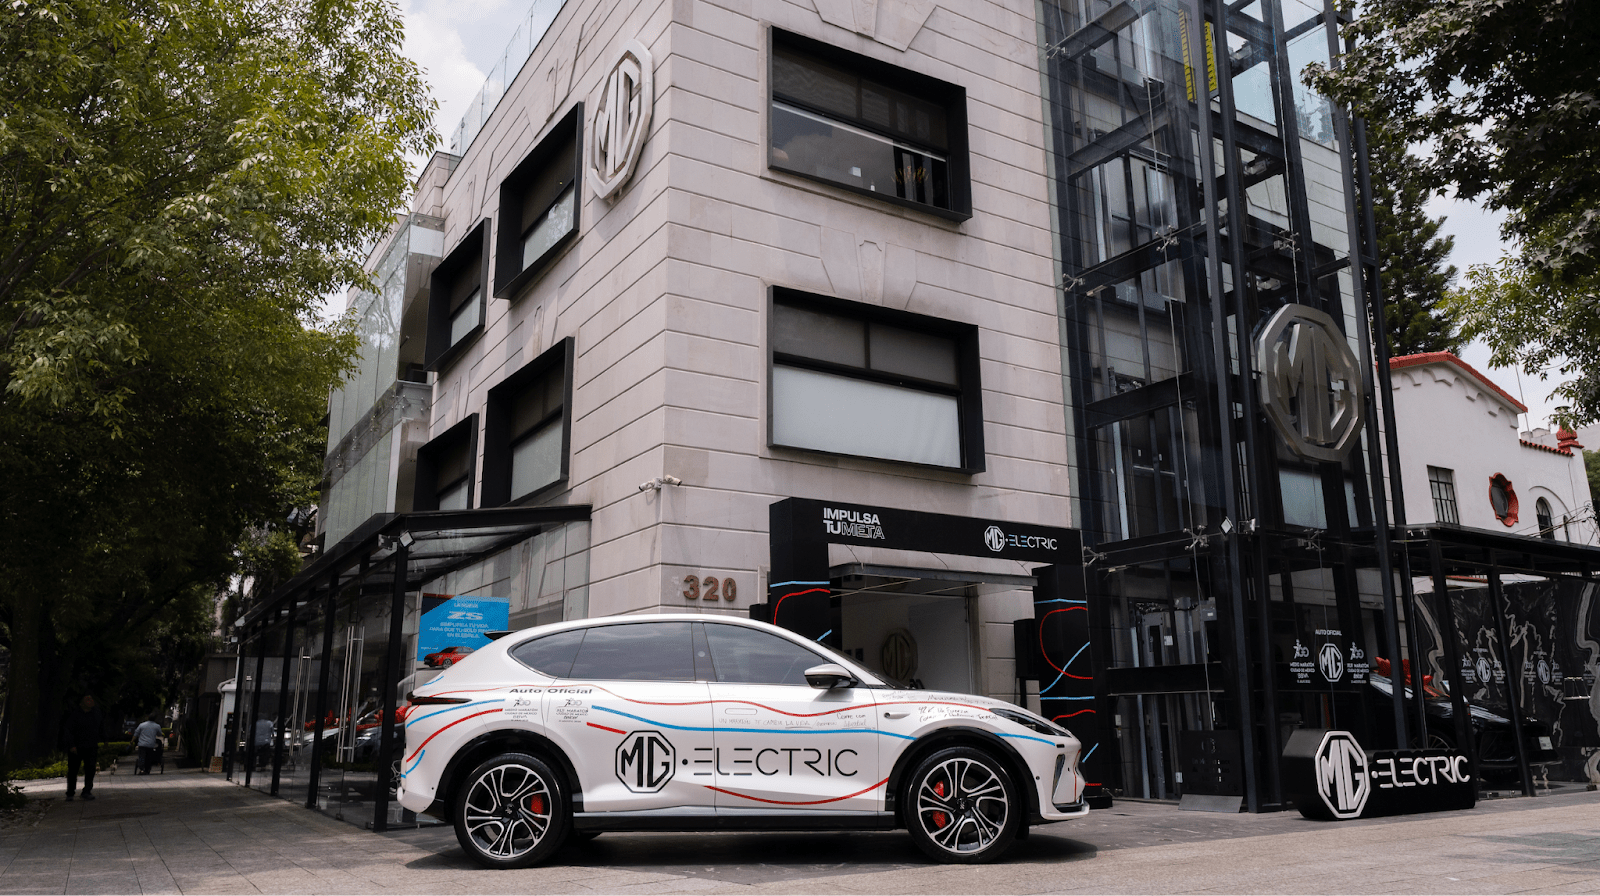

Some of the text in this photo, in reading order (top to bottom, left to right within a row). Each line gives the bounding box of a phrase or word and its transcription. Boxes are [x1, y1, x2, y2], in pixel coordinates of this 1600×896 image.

[593, 55, 644, 182] MG
[1271, 321, 1351, 446] MG
[823, 507, 881, 525] IMPULSA
[985, 527, 1004, 550] MG
[683, 574, 737, 602] 320
[1320, 646, 1342, 679] MG
[620, 735, 858, 788] MG ELECTRIC
[1320, 738, 1471, 811] MG ELECTRIC
